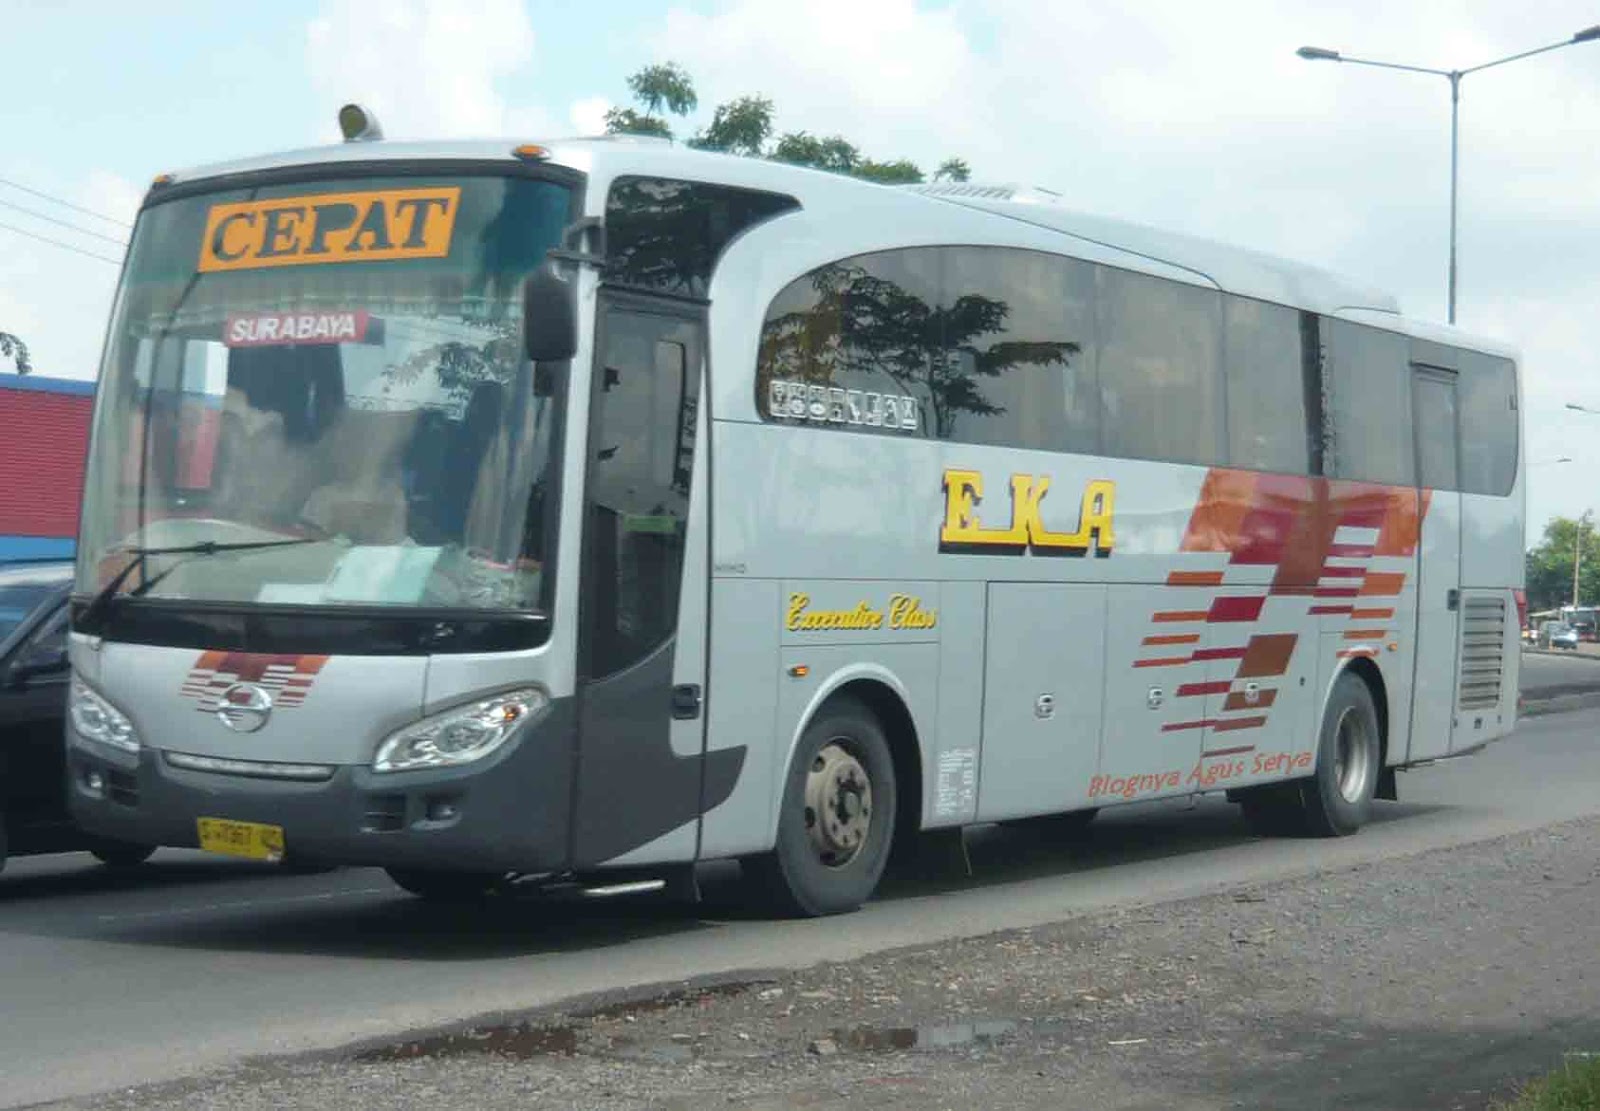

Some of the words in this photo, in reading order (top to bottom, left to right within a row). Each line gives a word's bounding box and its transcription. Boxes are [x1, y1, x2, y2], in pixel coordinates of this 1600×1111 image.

[212, 198, 450, 262] CEPAT
[229, 313, 357, 342] SURABAYA
[938, 469, 1116, 557] EKA
[785, 592, 885, 631] Executive
[888, 592, 937, 630] Class
